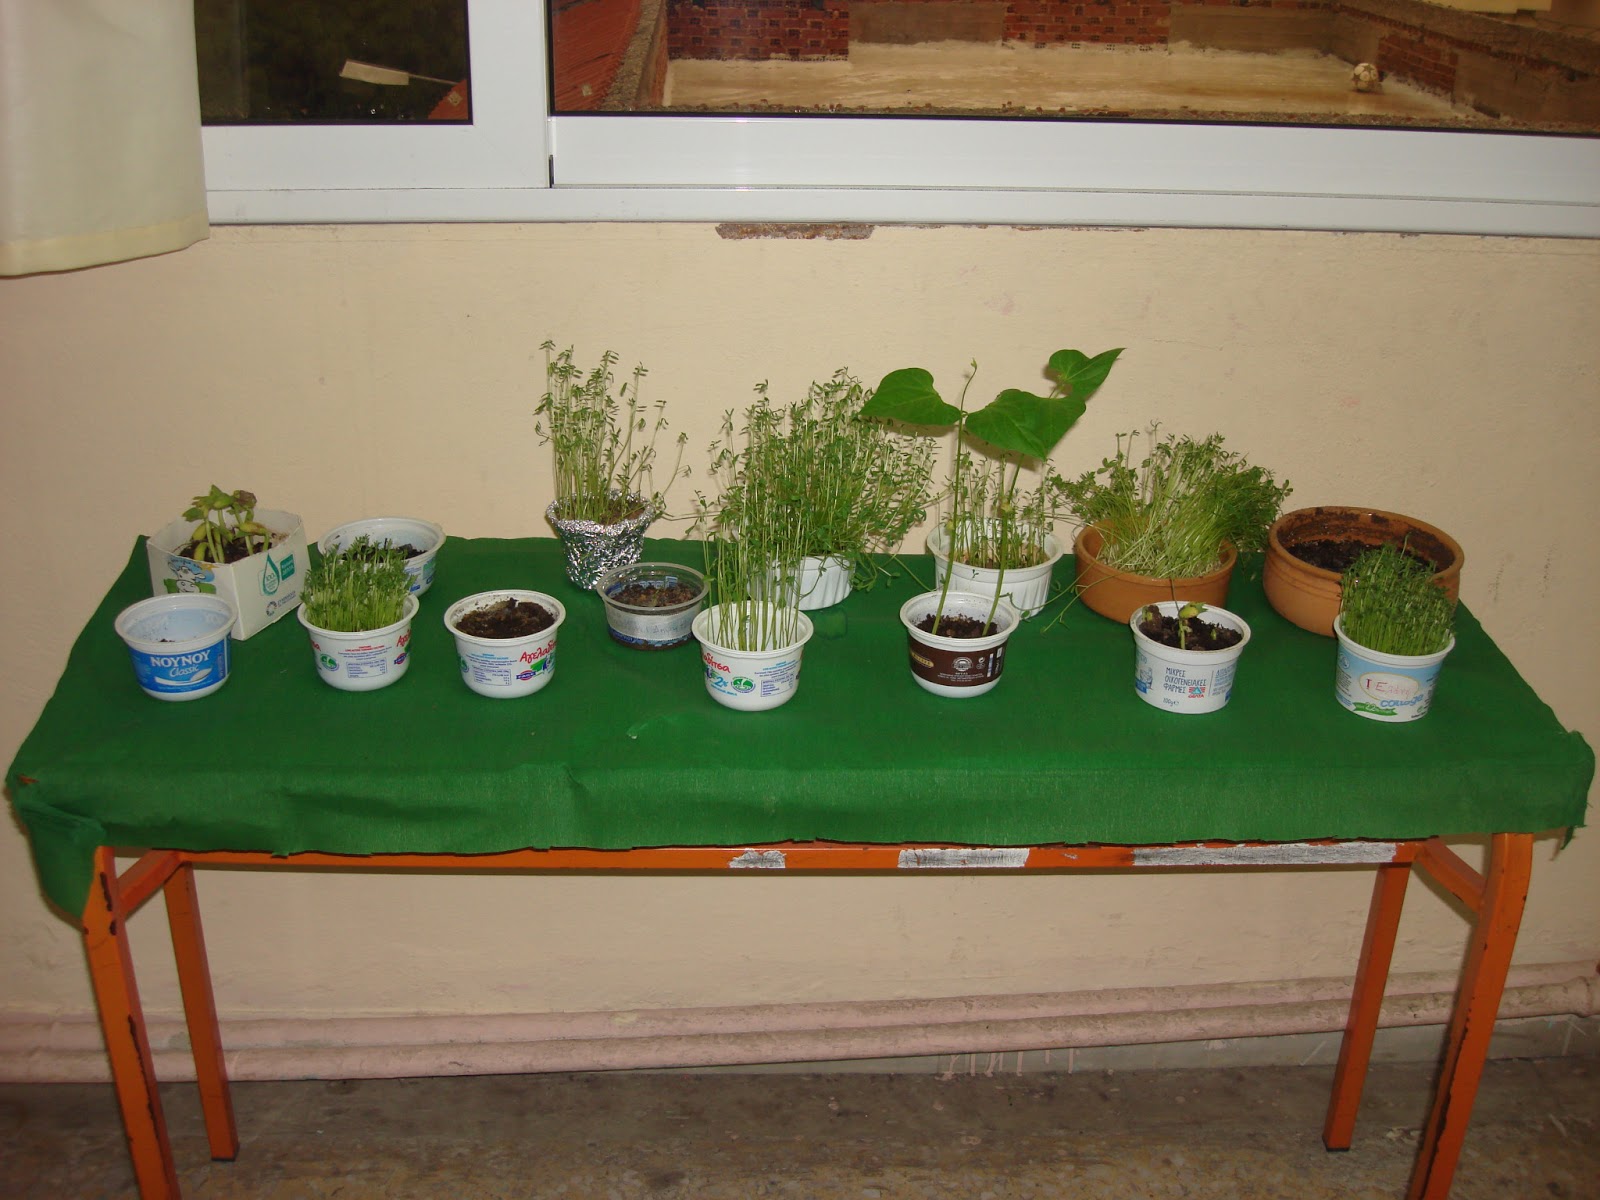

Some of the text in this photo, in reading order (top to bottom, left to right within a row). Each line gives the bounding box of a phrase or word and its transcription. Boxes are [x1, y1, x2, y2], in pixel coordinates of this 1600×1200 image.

[150, 650, 210, 668] NOYNOY
[169, 664, 200, 678] Classic
[1165, 667, 1186, 678] ΜΙΚΡΕΣ
[1163, 683, 1186, 694] ΦΑΡΜΕΣ
